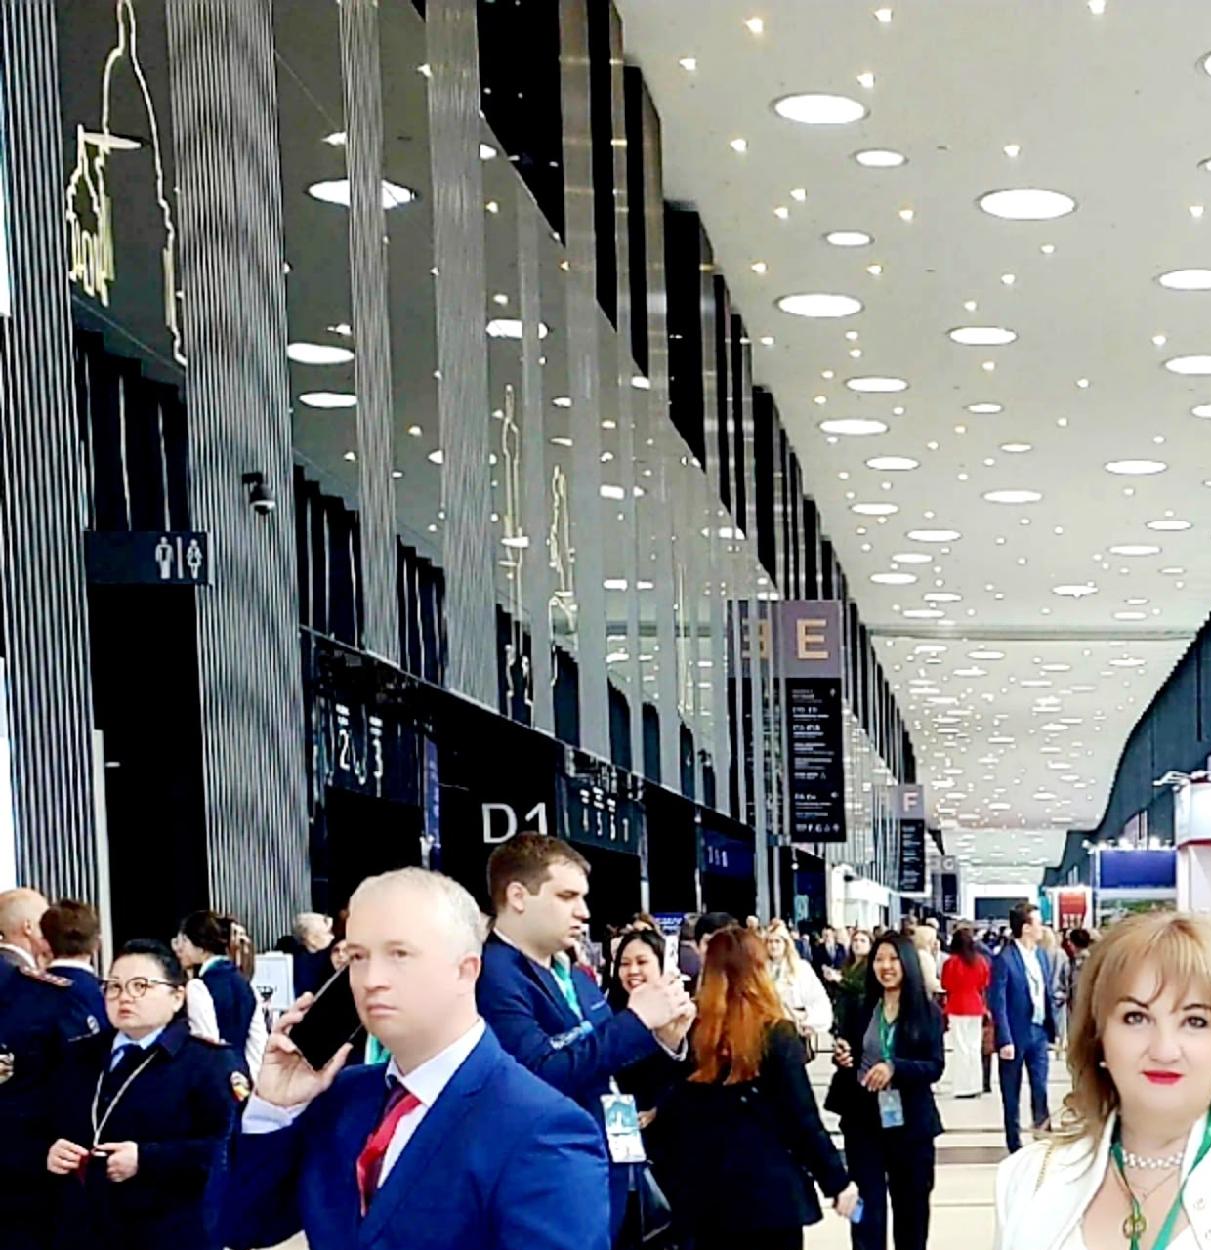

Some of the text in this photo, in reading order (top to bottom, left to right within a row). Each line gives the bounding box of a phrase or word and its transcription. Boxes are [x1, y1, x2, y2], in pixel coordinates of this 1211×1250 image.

[796, 618, 829, 660] E
[480, 801, 549, 844] D1
[903, 792, 919, 813] F
